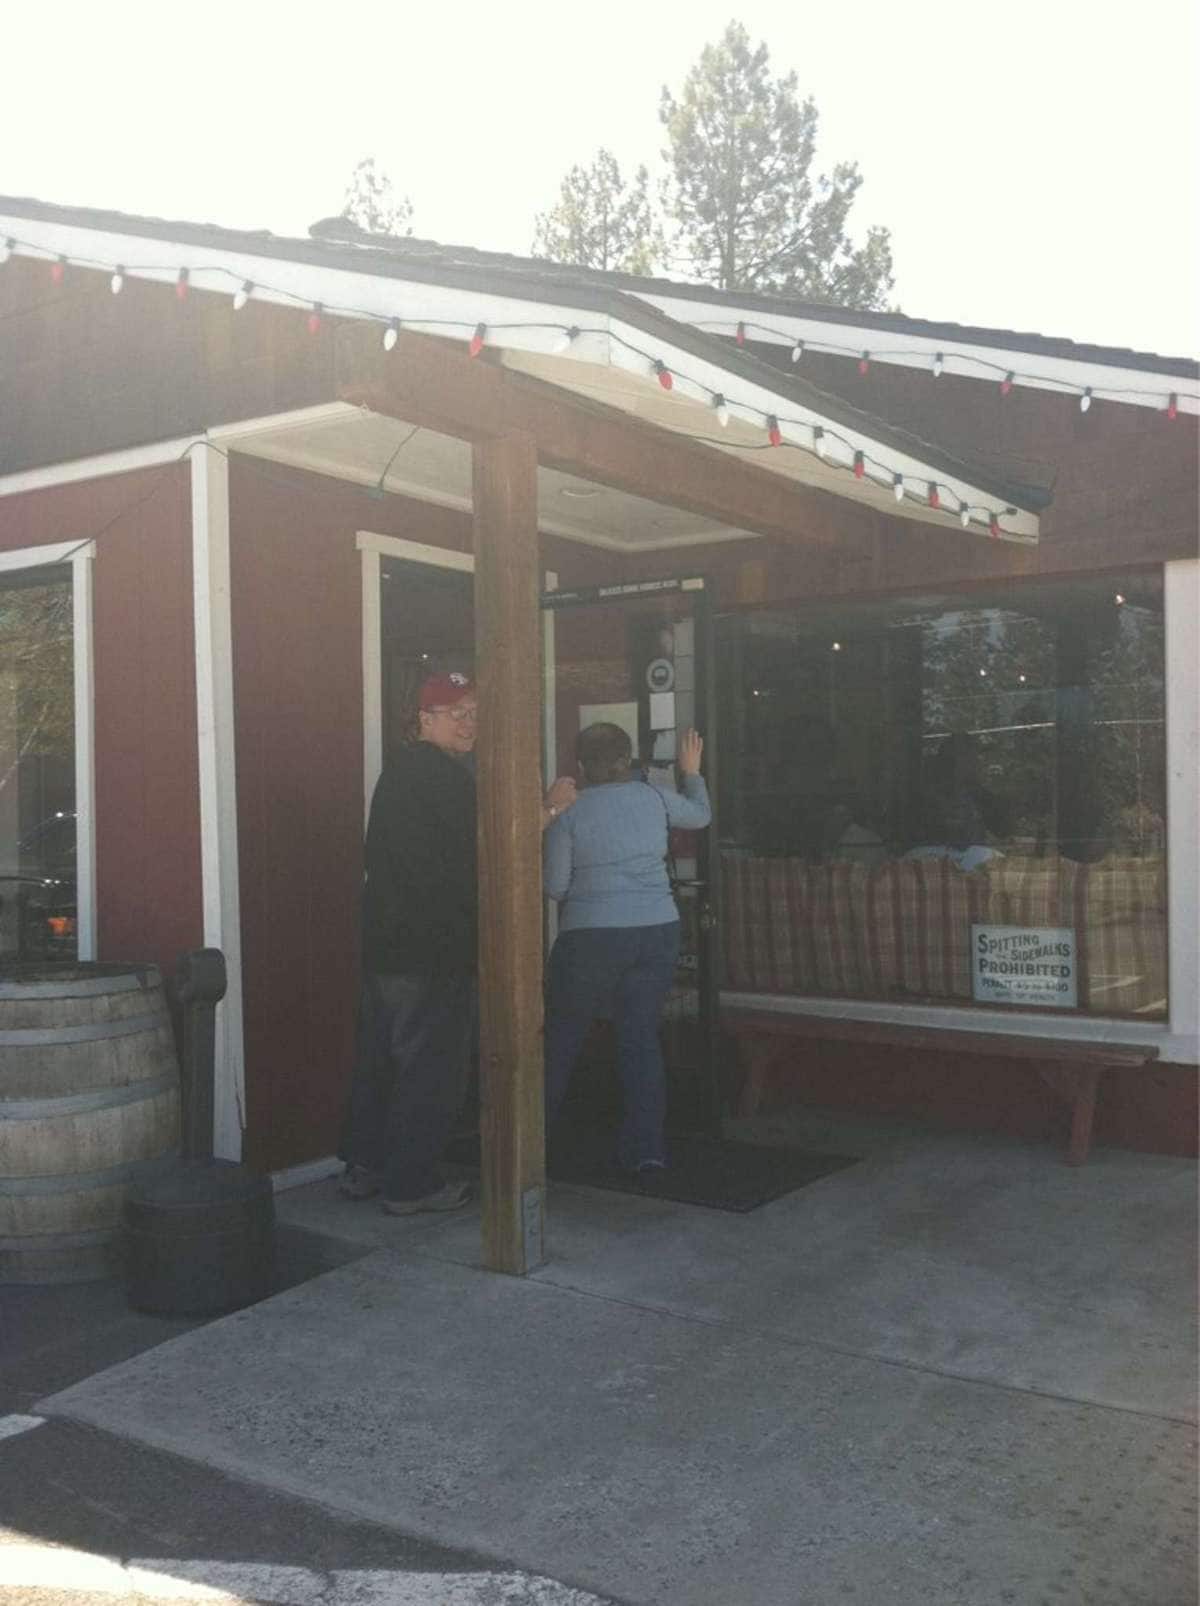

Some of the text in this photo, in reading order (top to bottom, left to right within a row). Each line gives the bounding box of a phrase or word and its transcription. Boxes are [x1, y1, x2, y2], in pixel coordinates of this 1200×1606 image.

[977, 934, 1040, 954] SPITTING
[1010, 942, 1071, 962] SIDEWALKS
[978, 958, 1071, 978] PROHIBITED
